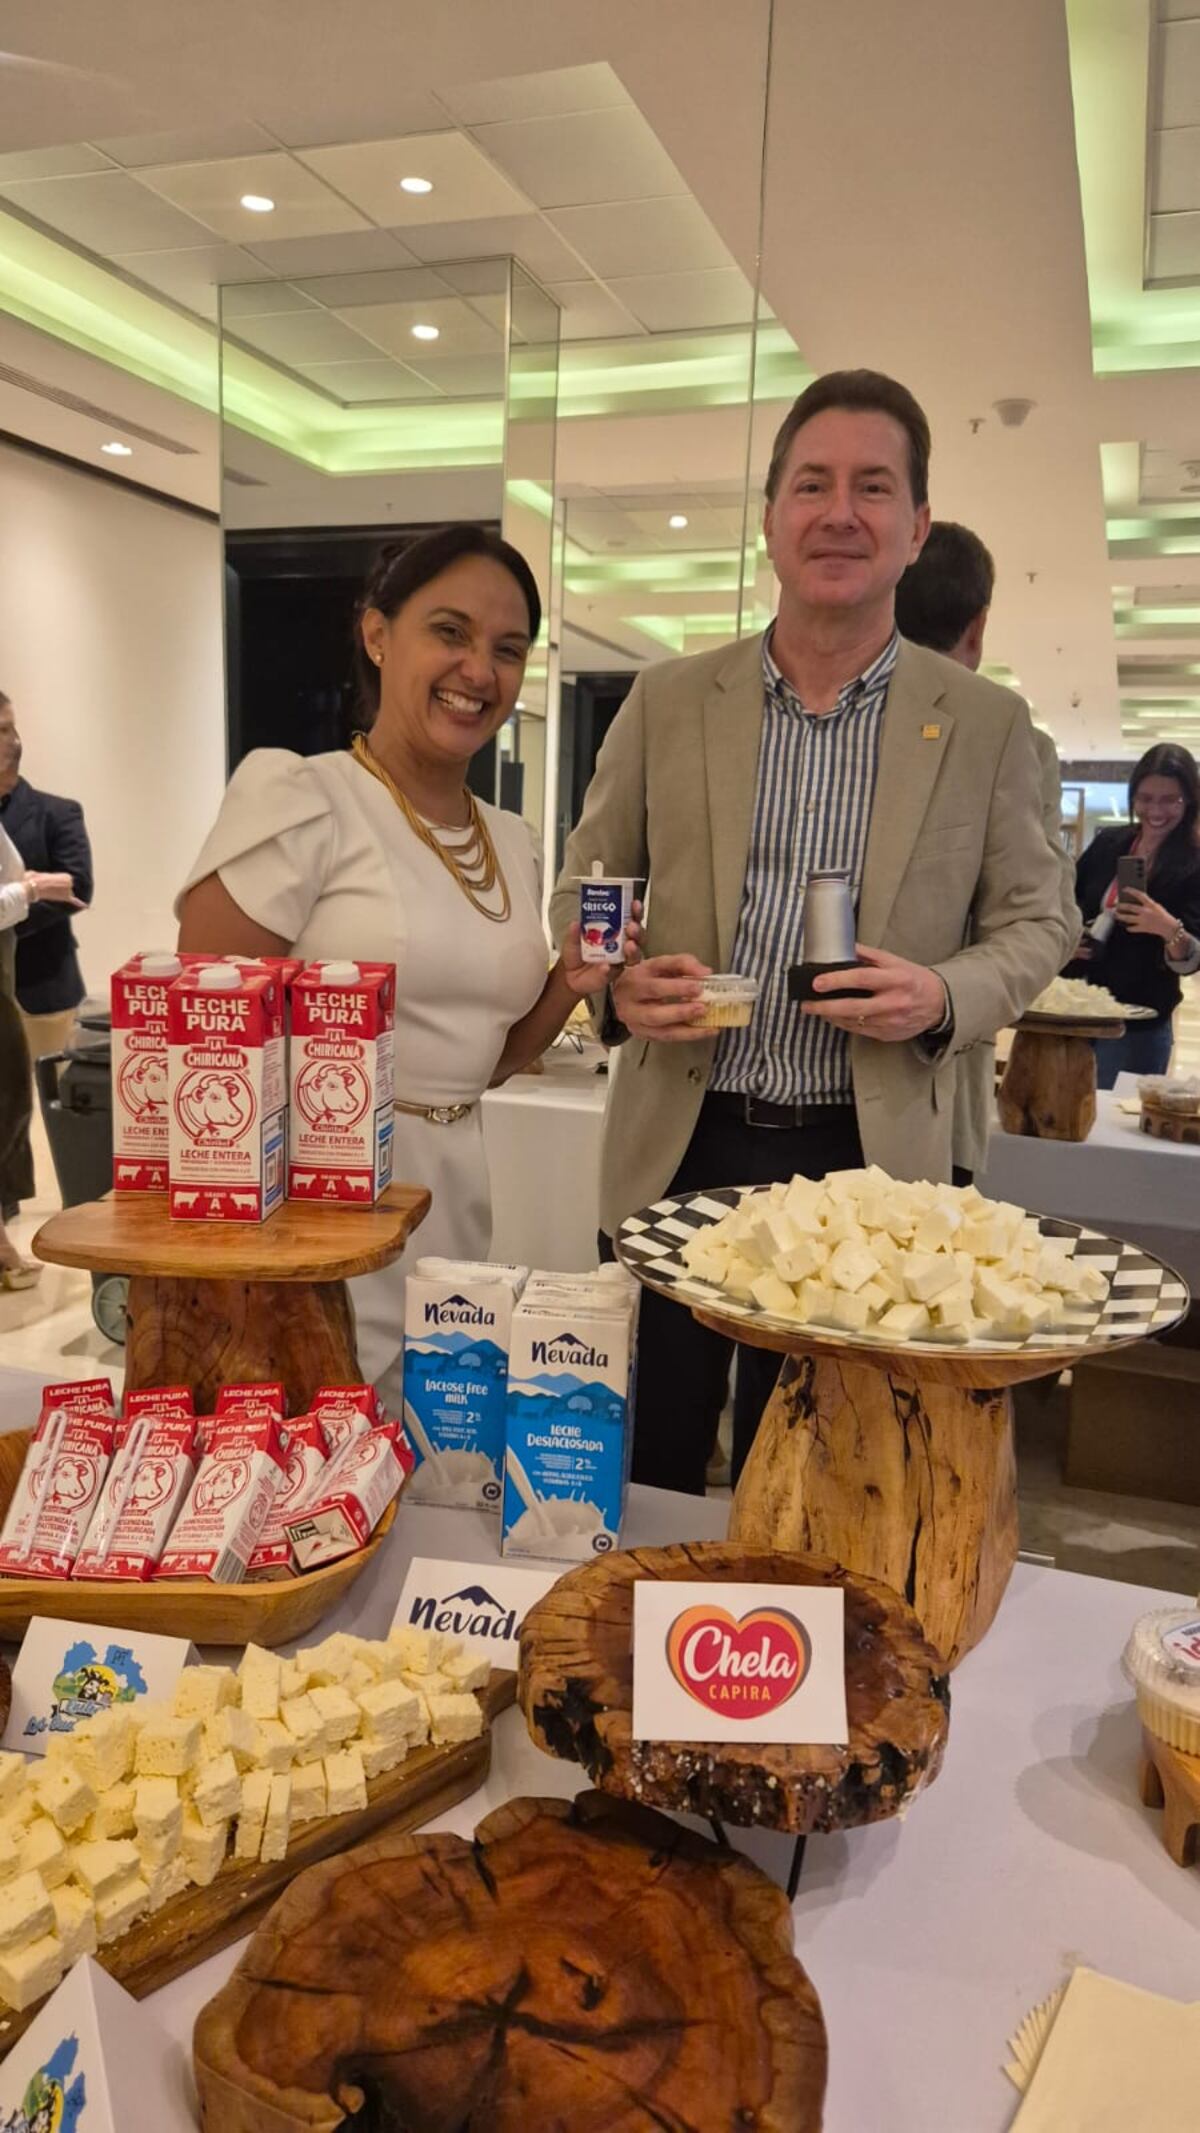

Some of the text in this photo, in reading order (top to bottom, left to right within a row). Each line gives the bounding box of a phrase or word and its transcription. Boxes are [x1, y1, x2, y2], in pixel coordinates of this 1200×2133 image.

[123, 984, 168, 1000] LECH
[128, 1000, 168, 1016] PUR
[181, 996, 251, 1016] LECHE
[304, 991, 369, 1011] LECHE
[186, 1013, 247, 1032] PURA
[308, 1006, 364, 1026] PURA
[128, 1036, 168, 1050] CHIRICA
[330, 1031, 341, 1043] LA
[210, 1040, 222, 1051] LA
[307, 1042, 361, 1059] CHIRICANA
[186, 1051, 245, 1068] CHIRICANA
[298, 1133, 366, 1145] LECHE ENTERA
[180, 1148, 252, 1161] LECHE ENTERA
[152, 1171, 162, 1183] A
[326, 1180, 336, 1191] A
[210, 1198, 222, 1210] A
[424, 1302, 496, 1327] Nevada
[531, 1340, 609, 1369] Nevada
[683, 1625, 797, 1682] Chela
[708, 1684, 771, 1701] CAPIRA
